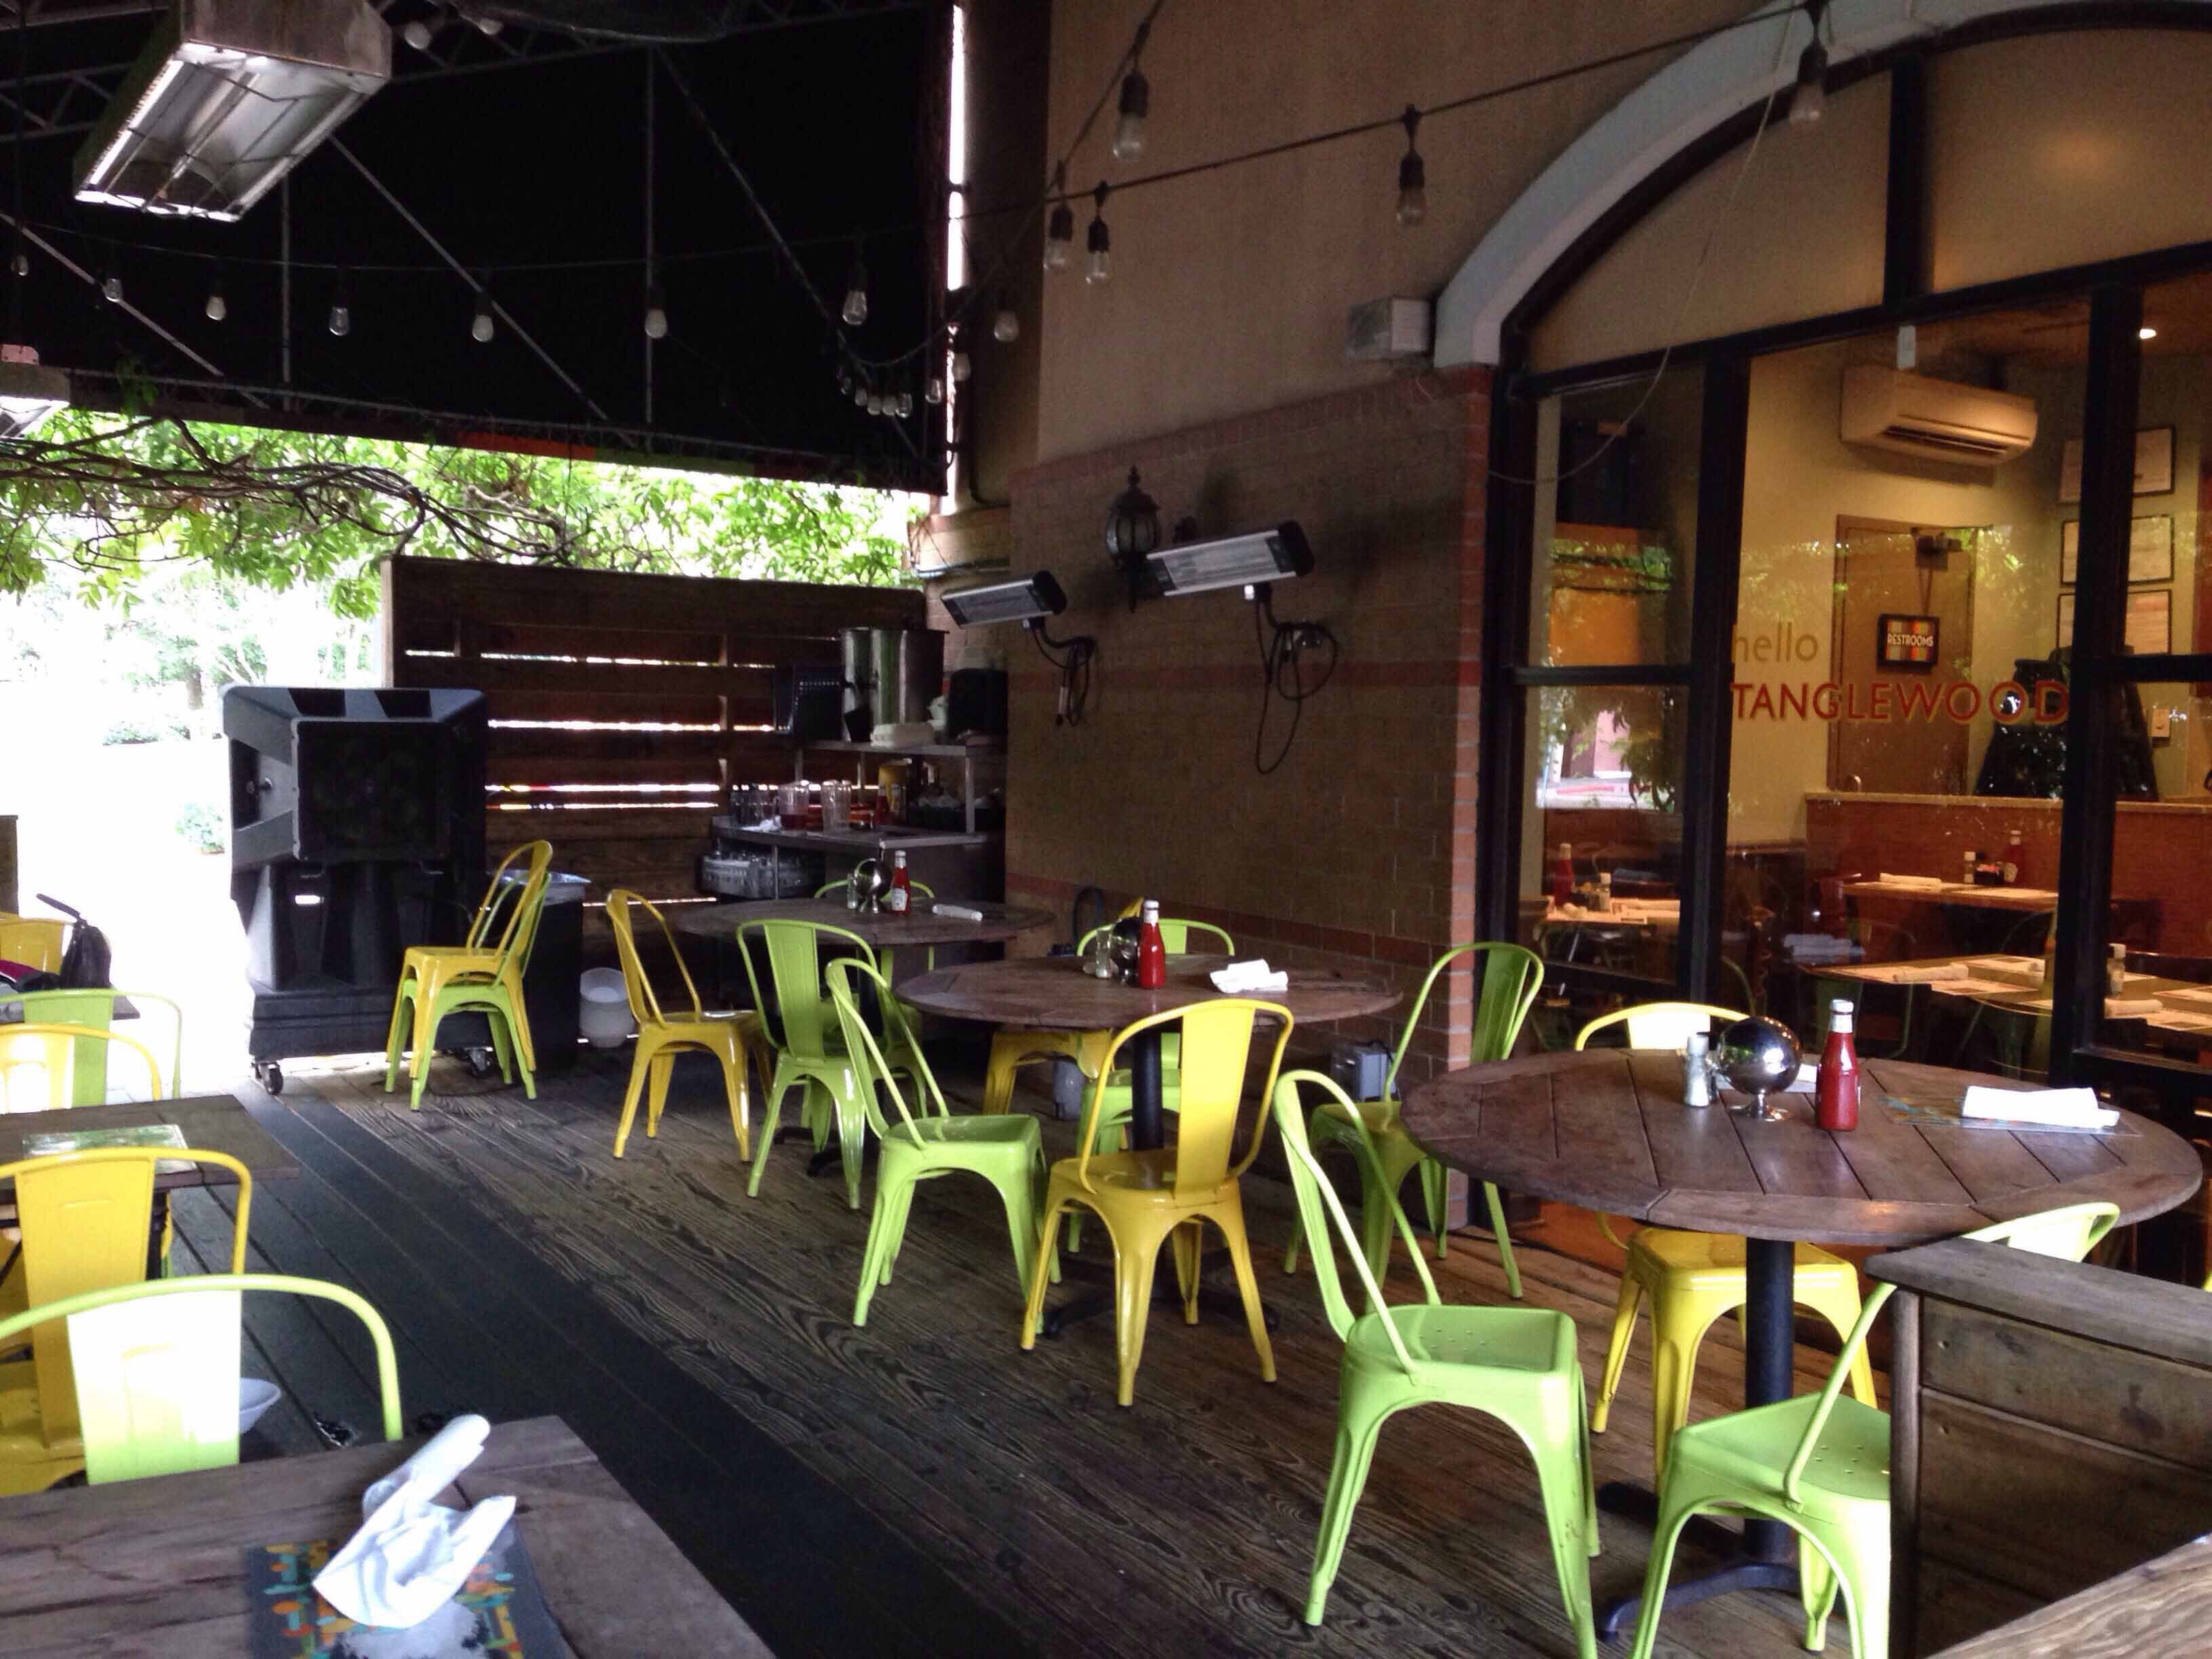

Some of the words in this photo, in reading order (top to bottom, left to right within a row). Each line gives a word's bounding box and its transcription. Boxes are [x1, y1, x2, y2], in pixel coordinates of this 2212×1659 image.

[1732, 621, 1818, 662] hello
[1887, 634, 1934, 647] RESTROOMS
[1730, 680, 2070, 724] TANGLEWOOD
